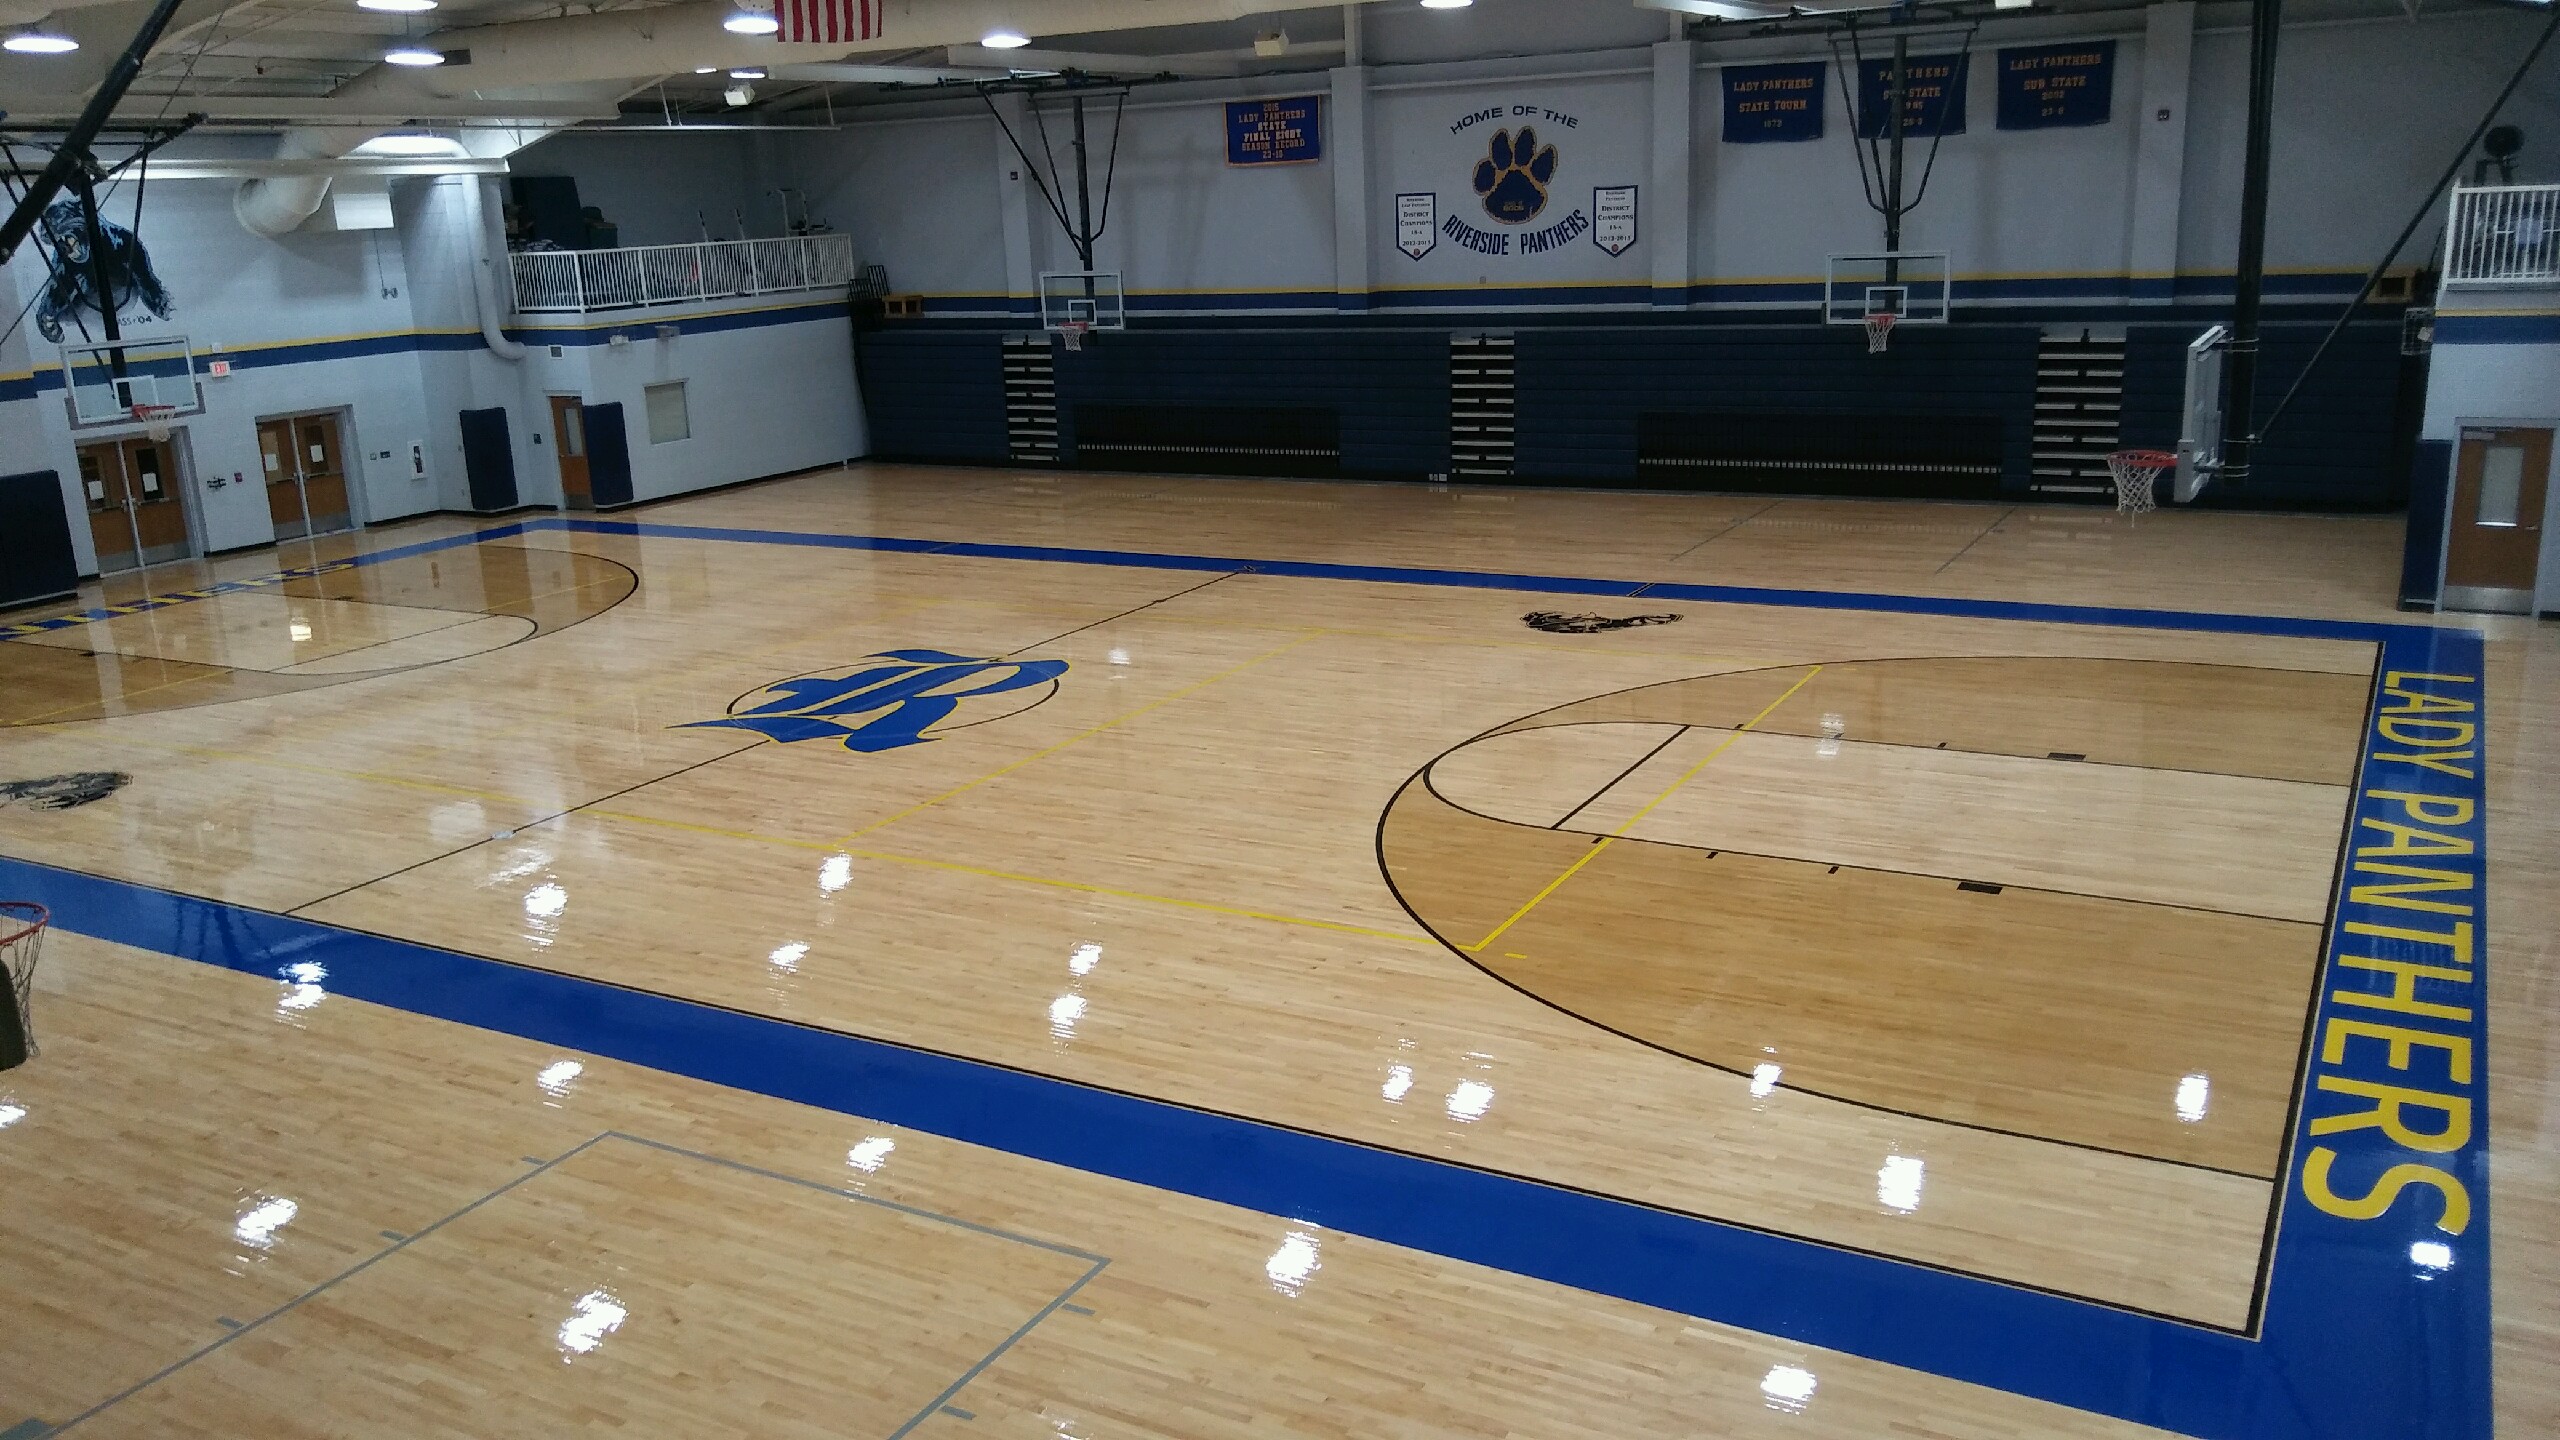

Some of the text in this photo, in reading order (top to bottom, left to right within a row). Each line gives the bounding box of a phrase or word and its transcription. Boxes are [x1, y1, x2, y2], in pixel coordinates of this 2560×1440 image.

[2010, 53, 2102, 71] LADY PANTHERS
[1878, 66, 1949, 81] PATHERS
[1733, 78, 1814, 92] LADY PANTHERS
[2051, 75, 2086, 87] STATE
[1909, 86, 1941, 98] STATE
[1739, 101, 1770, 112] STATE
[1238, 109, 1306, 123] LADY PANTHERS
[1450, 104, 1579, 135] HOME OF THE
[1257, 120, 1287, 131] STATE
[1243, 129, 1302, 142] FINAL EIGHT
[1442, 208, 1590, 256] RIVERSIDE PANTHERS
[2301, 668, 2475, 1238] LADY PANTHERS
